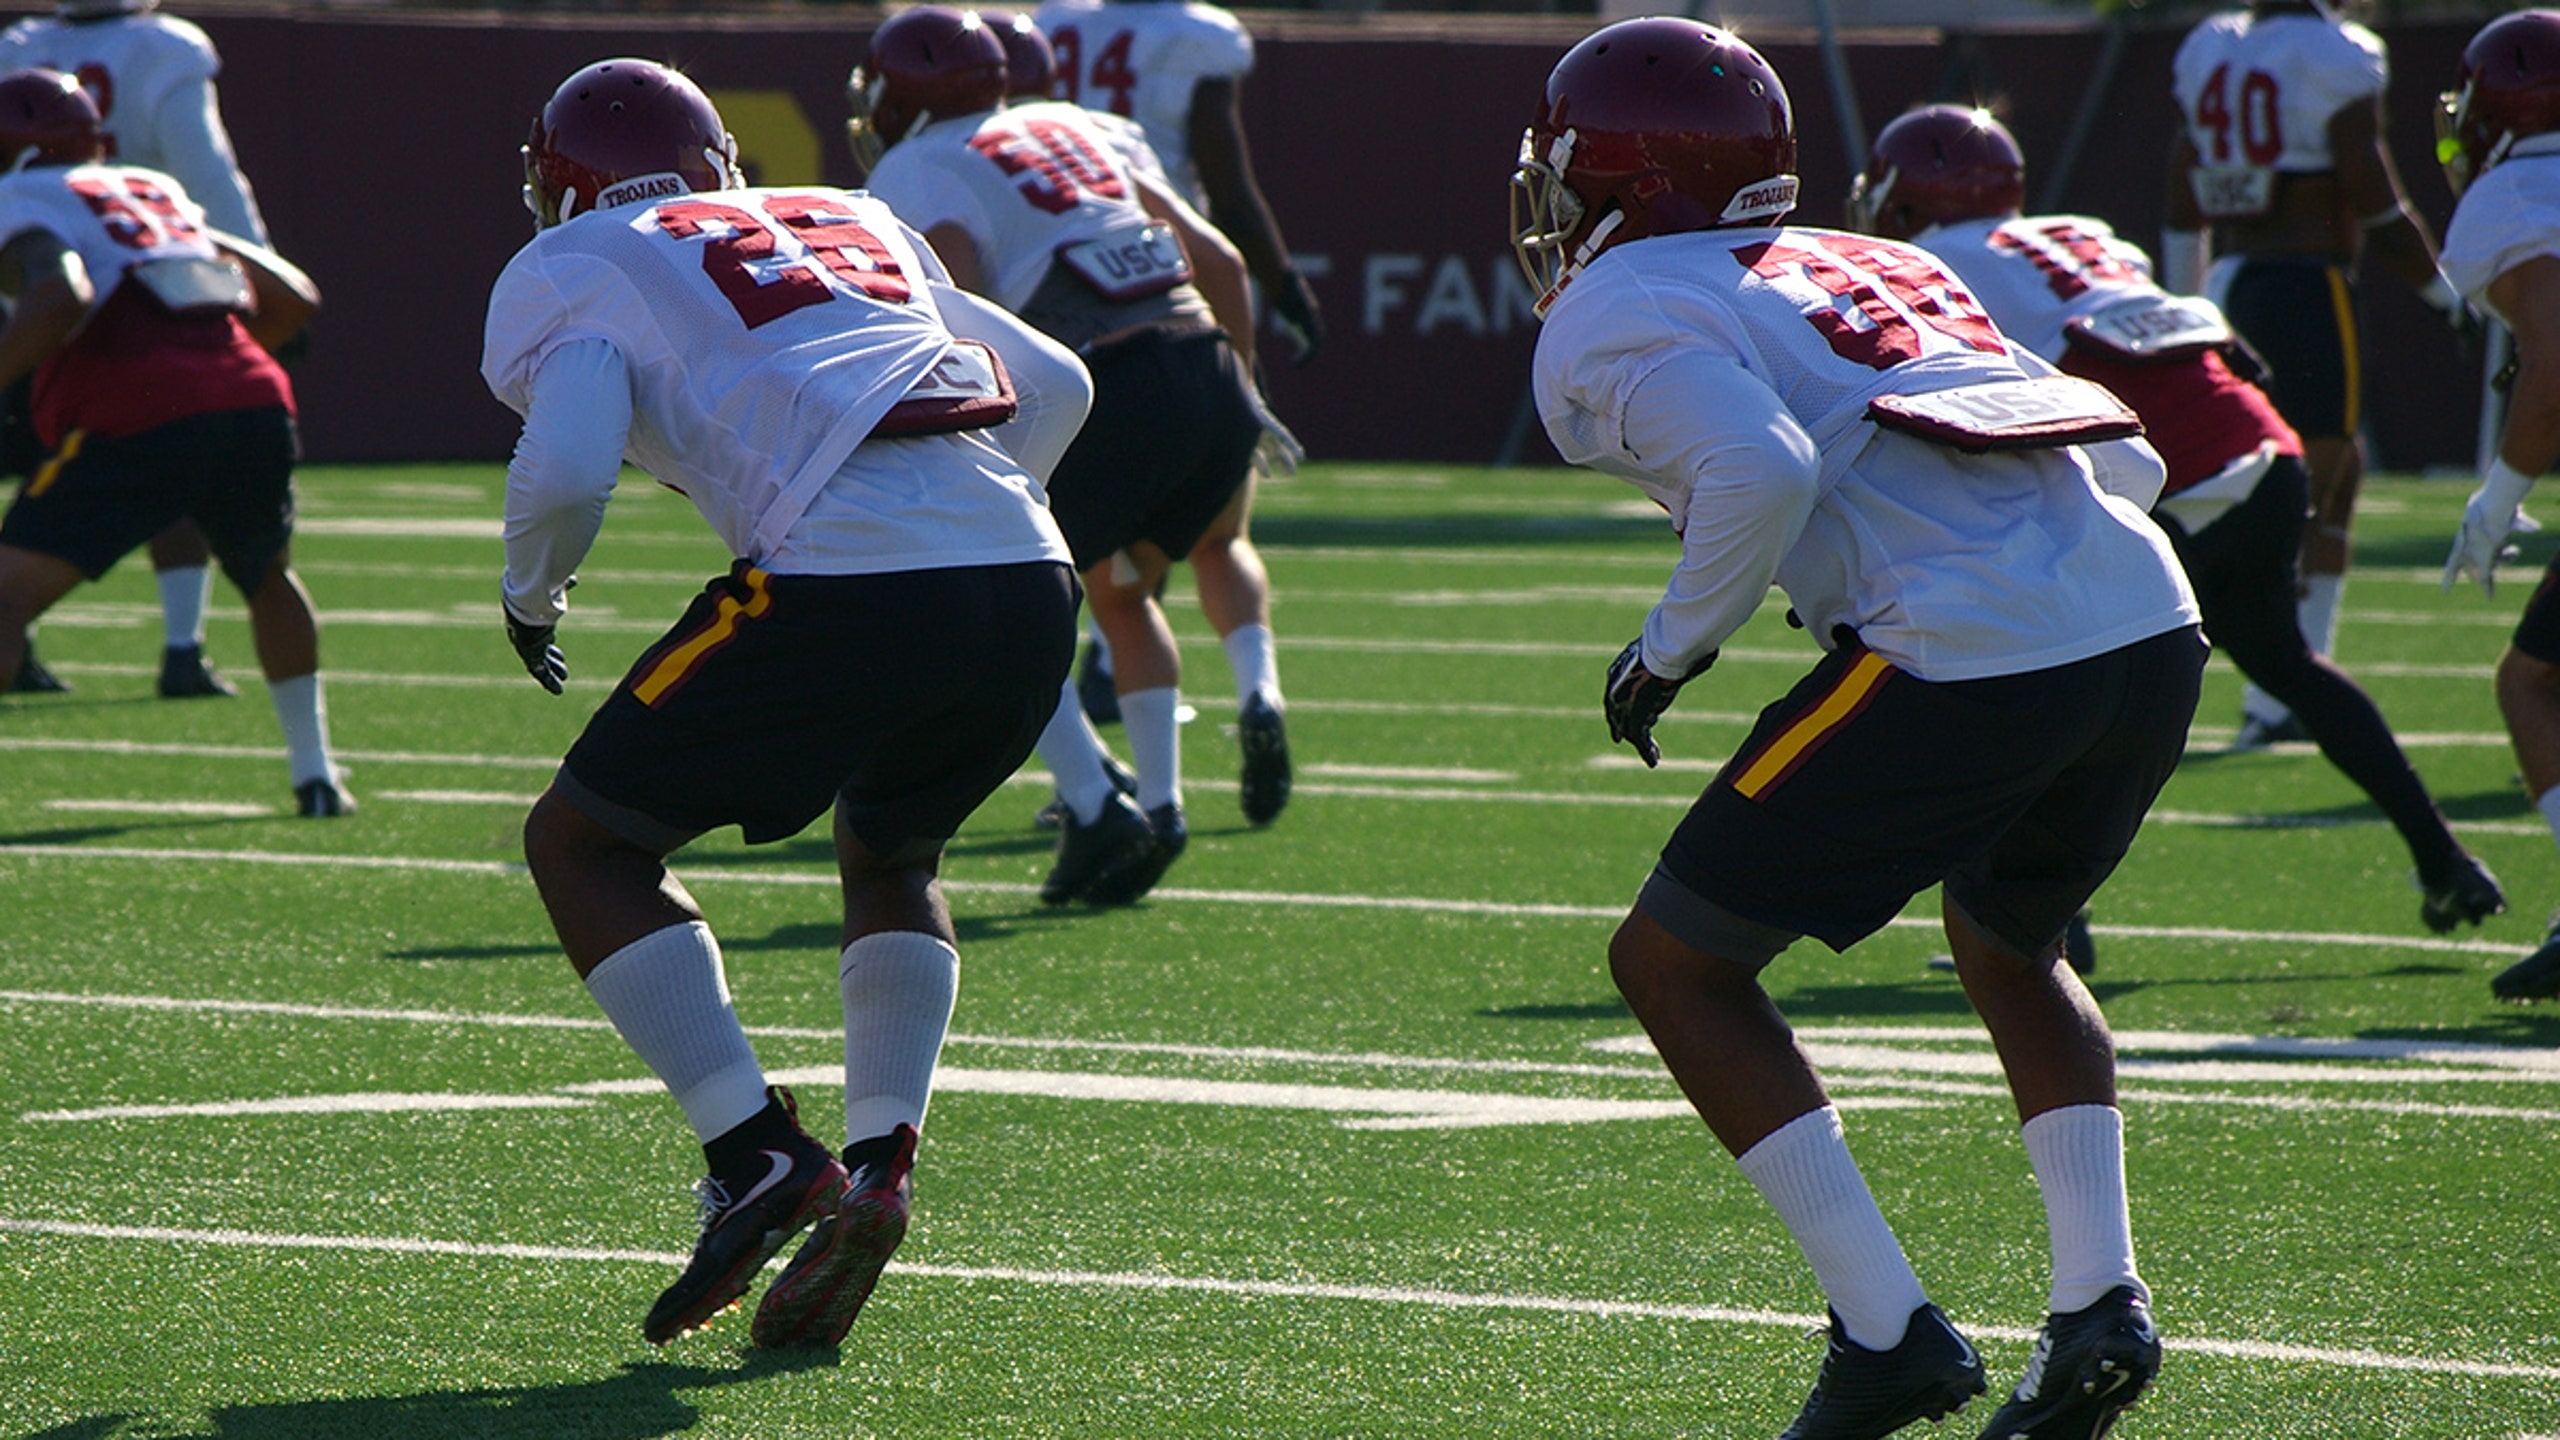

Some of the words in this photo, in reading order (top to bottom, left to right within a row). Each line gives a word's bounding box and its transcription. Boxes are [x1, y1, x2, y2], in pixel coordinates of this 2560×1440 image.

[2196, 62, 2283, 167] 40
[602, 177, 681, 208] TROJANS
[655, 194, 911, 331] 26
[1094, 239, 1173, 280] USC
[1942, 390, 2074, 421] US
